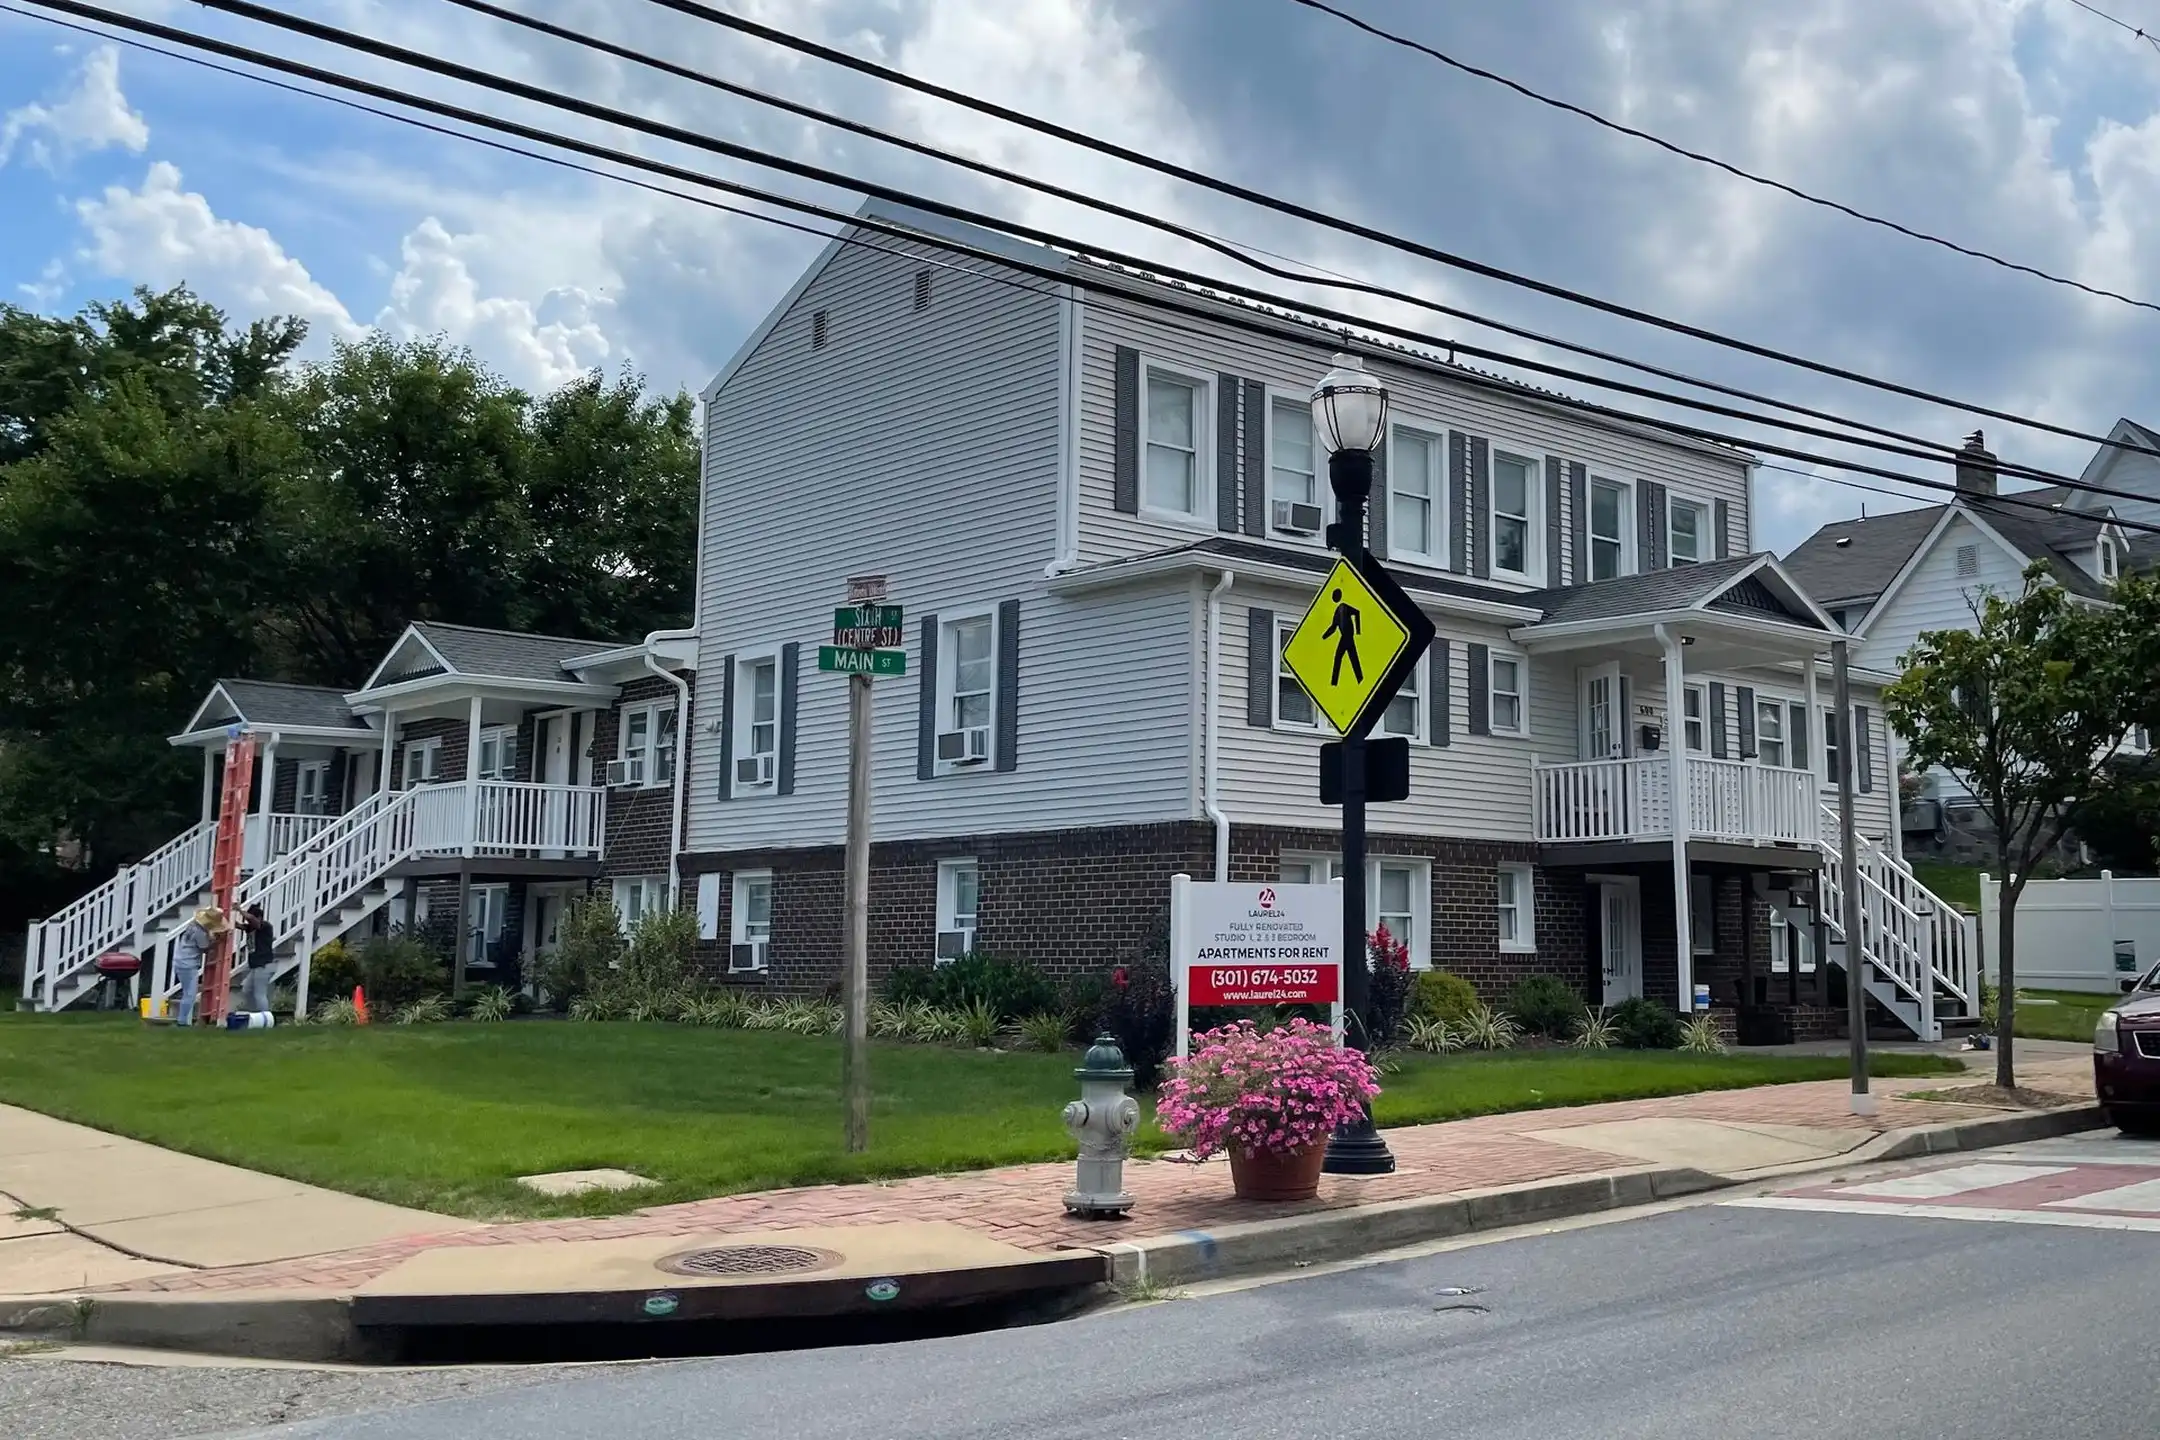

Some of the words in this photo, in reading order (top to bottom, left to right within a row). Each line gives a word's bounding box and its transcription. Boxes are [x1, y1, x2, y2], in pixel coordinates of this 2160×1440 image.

[834, 650, 874, 670] MAIN
[881, 658, 891, 668] ST
[1229, 923, 1254, 931] FULLY
[1256, 923, 1303, 931] RENOVATED
[1277, 933, 1316, 942] BEDROOM
[1198, 948, 1276, 959] APARTMENTS
[1279, 947, 1300, 958] FOR
[1302, 947, 1329, 958] RENT
[1211, 969, 1248, 988] (301)
[1251, 969, 1318, 985] 674-5032
[1223, 989, 1307, 1000] www.laurel24.com
